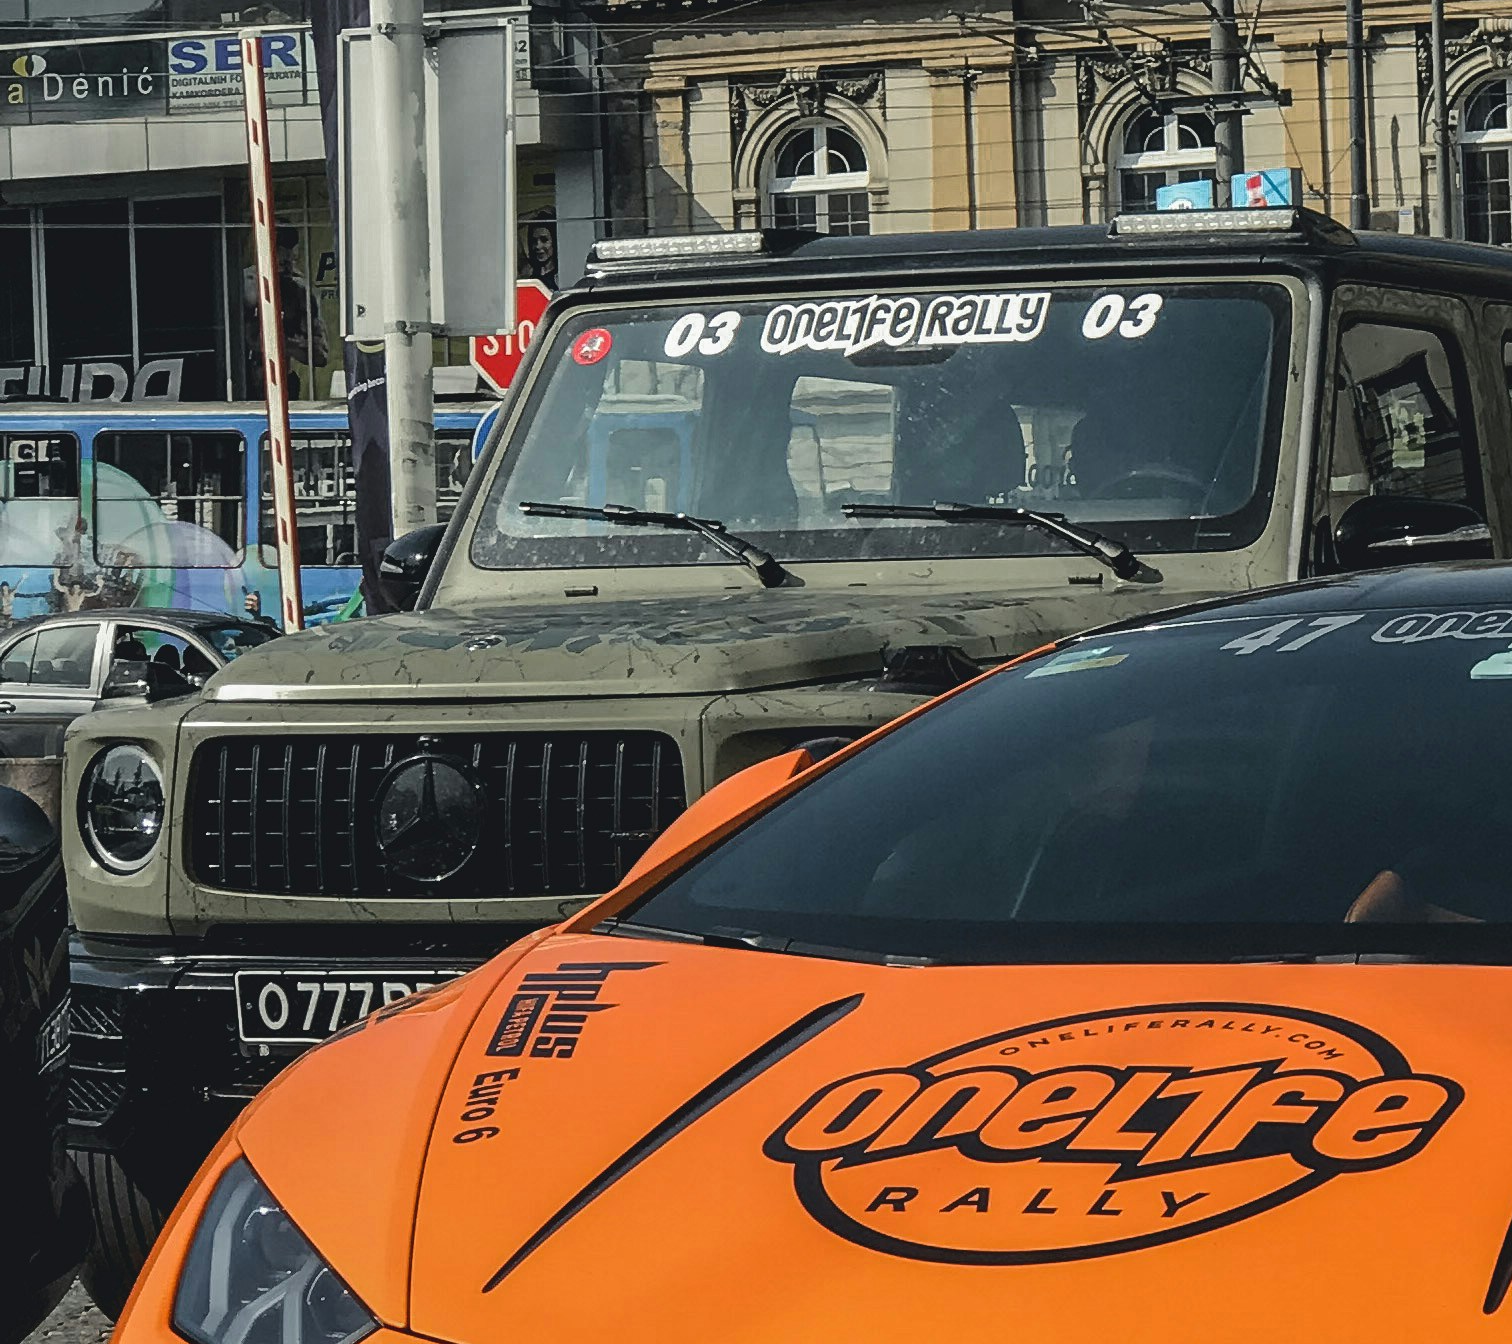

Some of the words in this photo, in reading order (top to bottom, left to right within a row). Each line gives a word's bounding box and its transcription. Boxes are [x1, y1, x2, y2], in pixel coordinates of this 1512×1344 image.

[43, 66, 153, 102] Denić
[171, 76, 227, 88] DIGITALNIH
[483, 319, 535, 356] STO
[663, 310, 741, 358] 03
[1081, 294, 1163, 340] 03
[1219, 614, 1365, 655] 47
[517, 962, 669, 1059] hplus
[1000, 1017, 1345, 1061] ONELIFERALLY.COM
[460, 1067, 521, 1122] Euro
[452, 1126, 501, 1144] 6
[866, 1185, 1210, 1218] RALLY
